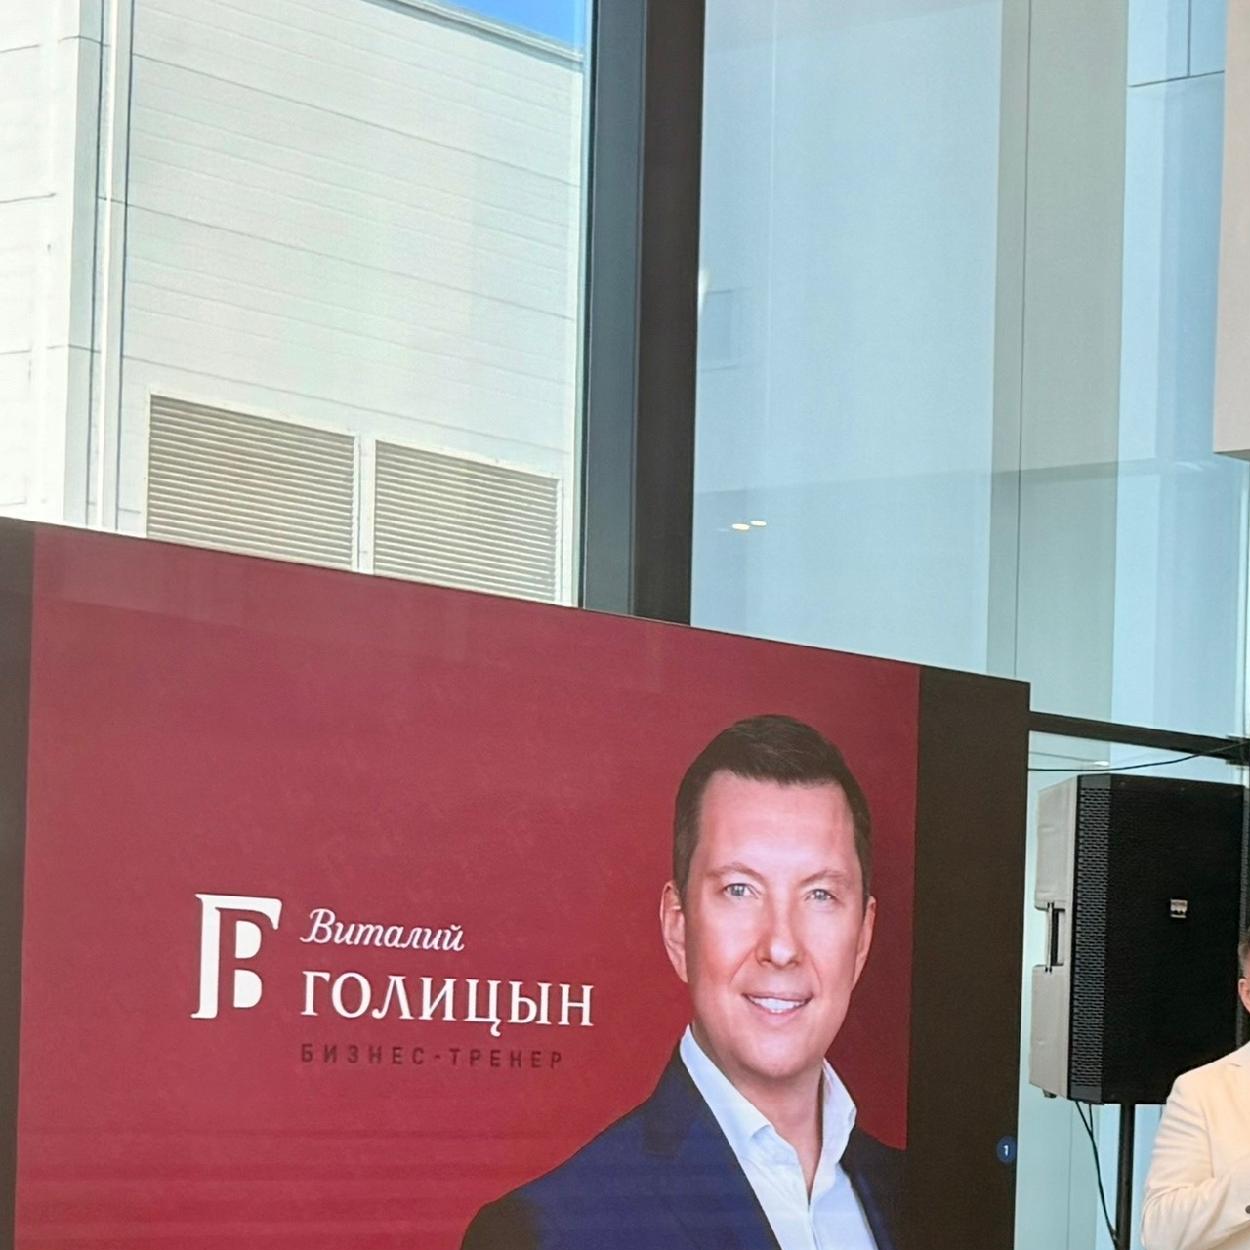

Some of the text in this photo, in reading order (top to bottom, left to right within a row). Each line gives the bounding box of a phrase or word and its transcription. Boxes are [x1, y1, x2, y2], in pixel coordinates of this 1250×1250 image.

[299, 908, 465, 952] Виталий
[300, 970, 594, 1037] ГОЛИЦЫН
[301, 1043, 563, 1069] БИЗНЕС-ТРЕНЕР
